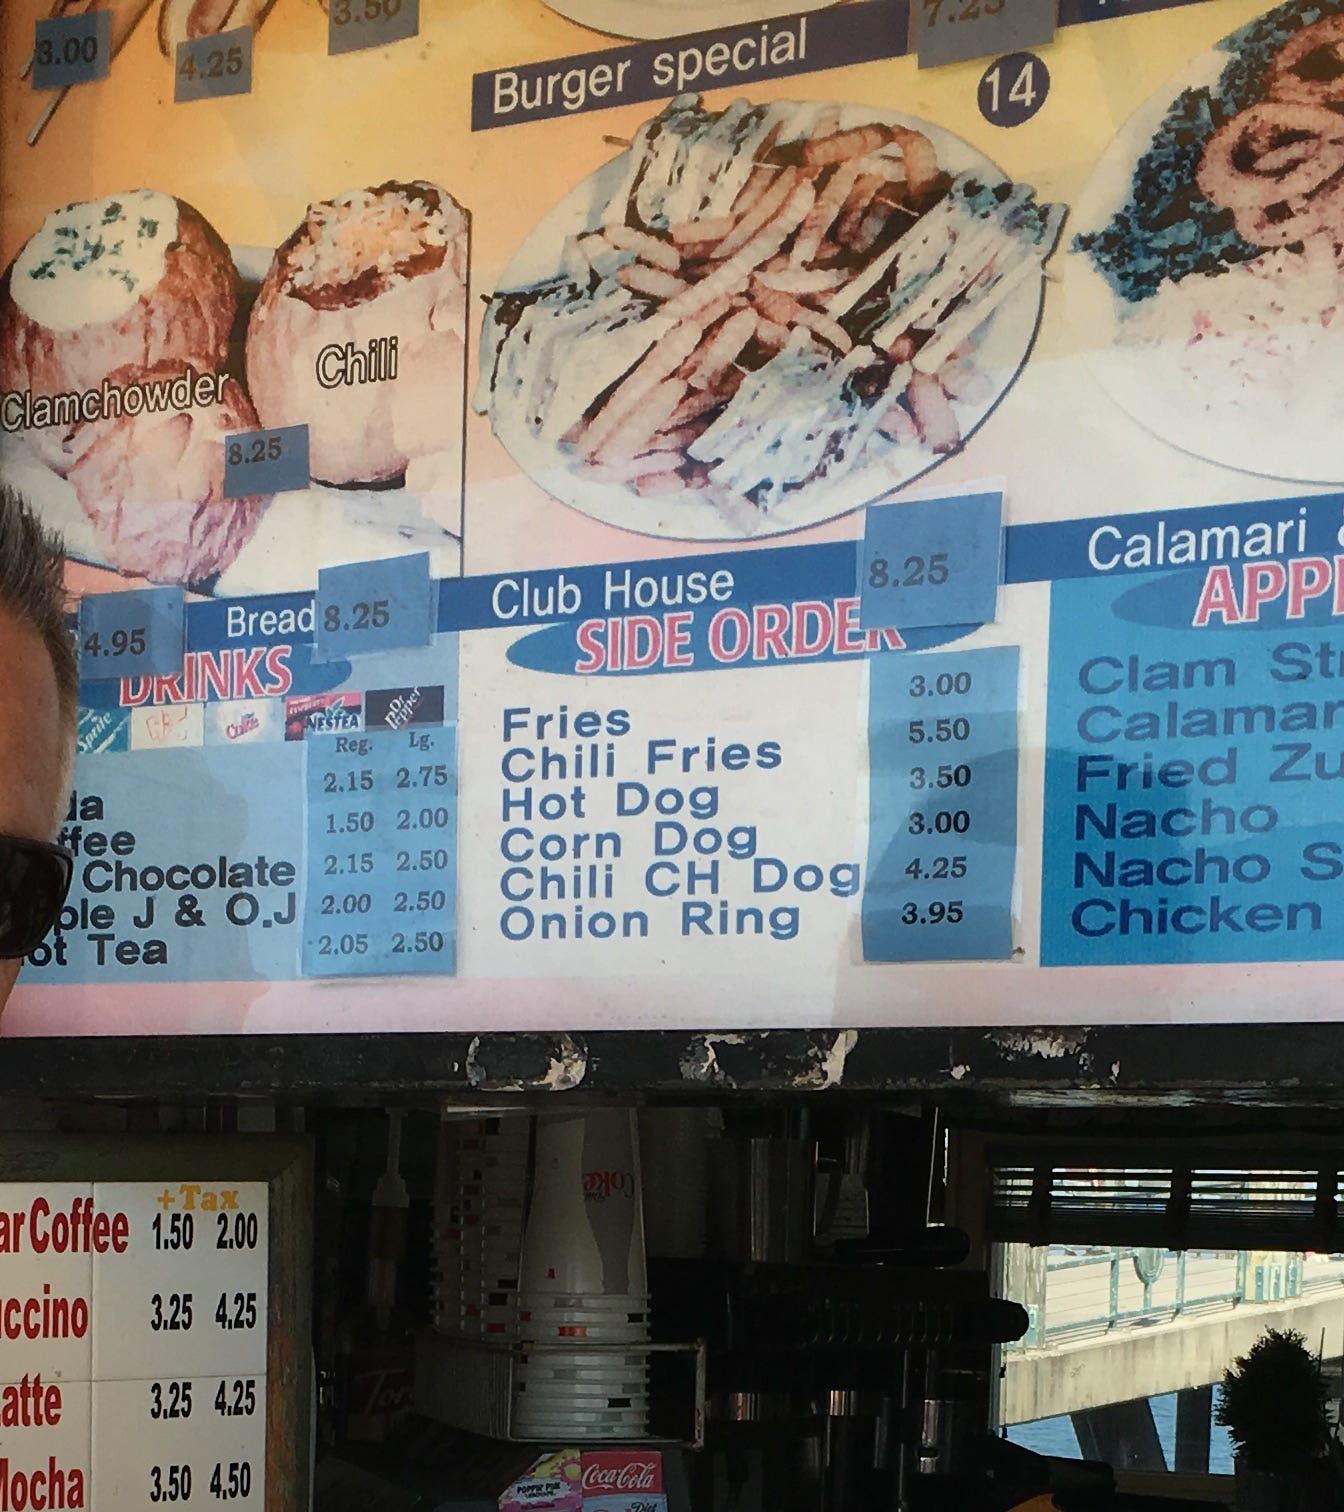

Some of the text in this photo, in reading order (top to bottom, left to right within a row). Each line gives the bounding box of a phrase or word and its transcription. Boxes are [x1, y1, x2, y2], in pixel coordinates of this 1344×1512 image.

[36, 36, 99, 66] 3.00
[179, 46, 244, 81] 4.25
[492, 18, 808, 115] Burger special
[984, 61, 1037, 113] 14
[315, 335, 400, 390] Chili
[0, 370, 230, 435] Clamchowder
[227, 436, 284, 468] 8.25
[1087, 506, 1309, 571] Calamari
[868, 553, 950, 589] 8.25
[492, 569, 735, 620] Club House
[227, 600, 316, 639] Bread
[324, 600, 390, 631] 8.25
[84, 628, 146, 658] 4.95
[574, 612, 694, 673] SIDE
[118, 644, 294, 707] DRINKS
[909, 672, 972, 697] 3.00
[1078, 652, 1236, 695] Clam
[503, 704, 631, 742] Fries
[908, 718, 971, 744] 5.50
[335, 732, 435, 756] Reg. Lg.
[501, 736, 783, 784] Chili Fries
[324, 766, 448, 793] 2.15 2.75
[909, 764, 972, 789] 3.50
[1076, 746, 1238, 794] Fried
[326, 807, 449, 834] 1.50 2.00
[502, 782, 720, 822] Hot Dog
[1075, 799, 1280, 841] Nacho
[908, 810, 971, 835] 3.00
[500, 821, 757, 863] Corn Dog
[82, 856, 296, 893] Chocolate
[324, 850, 448, 876] 2.15 2.50
[500, 856, 861, 901] Chili CH Dog
[905, 856, 967, 881] 4.25
[1073, 846, 1271, 890] Nacho
[133, 892, 296, 928] J & O.J
[320, 891, 445, 915] 2.00 2.50
[499, 899, 801, 941] Onion Ring
[901, 901, 964, 926] 3.95
[1072, 893, 1322, 938] Chicken
[87, 934, 167, 965] Tea
[318, 932, 444, 956] 2.05 2.50
[29, 1197, 129, 1255] Coffee
[152, 1213, 194, 1251] 1.50
[216, 1212, 258, 1250] 2.00
[151, 1293, 193, 1331] 3.25
[215, 1292, 257, 1330] 4.25
[151, 1381, 192, 1419] 3.25
[214, 1379, 256, 1417] 4.25
[150, 1464, 192, 1502] 3.50
[210, 1461, 251, 1500] 4.50
[582, 1463, 656, 1490] Coca-Cola
